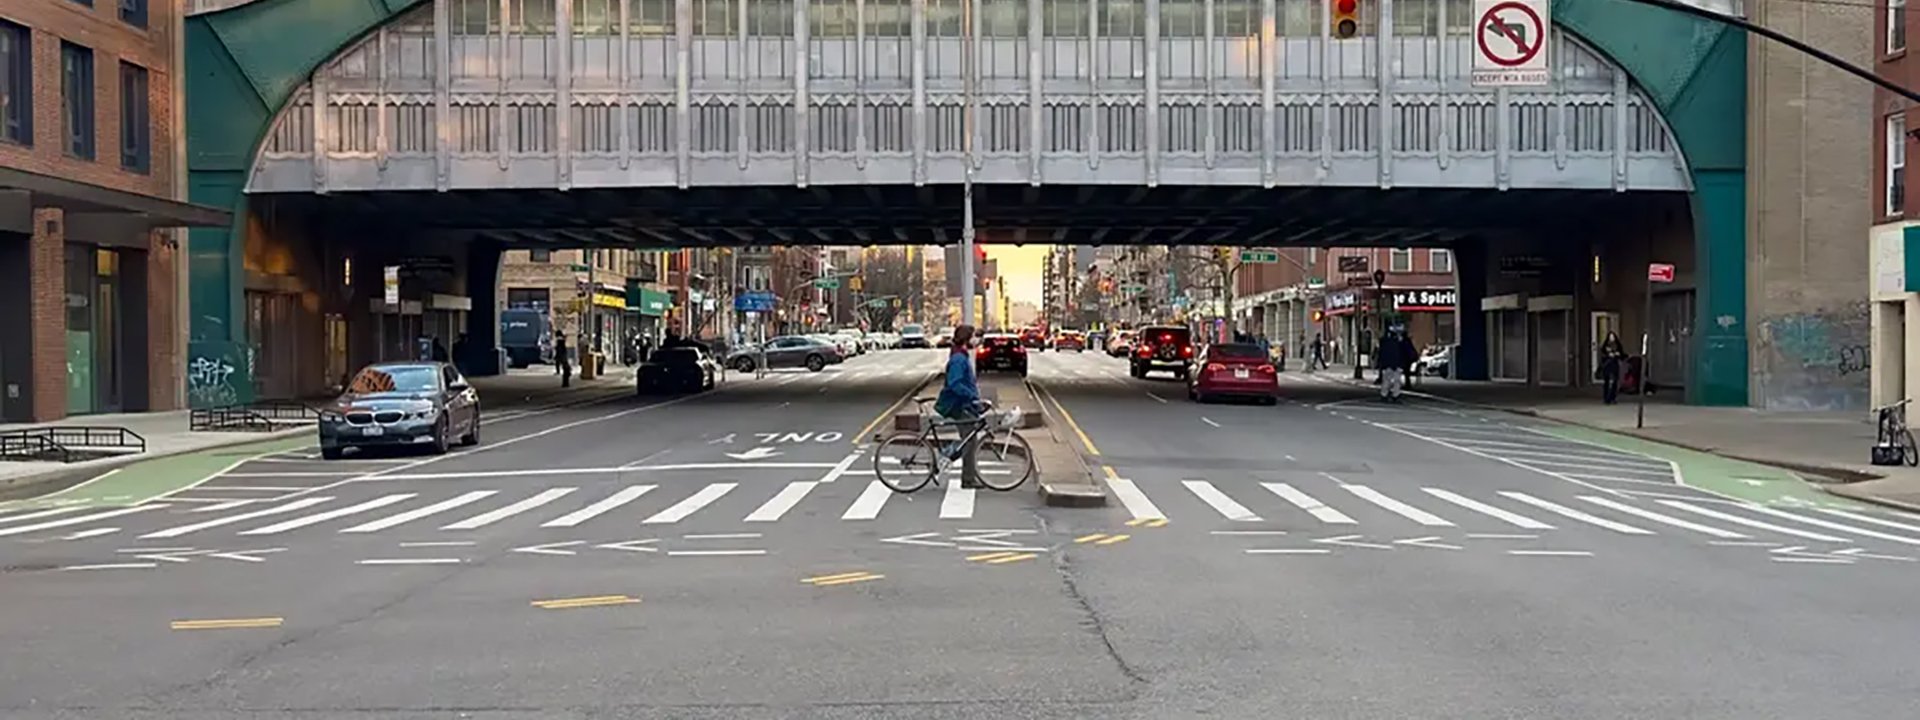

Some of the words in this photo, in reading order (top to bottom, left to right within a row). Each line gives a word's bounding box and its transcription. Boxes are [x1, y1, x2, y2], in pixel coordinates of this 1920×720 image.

[1474, 74, 1501, 82] EXCEPT
[1521, 74, 1546, 82] BUSES
[1408, 291, 1417, 304] &
[706, 431, 843, 445] ONLY
